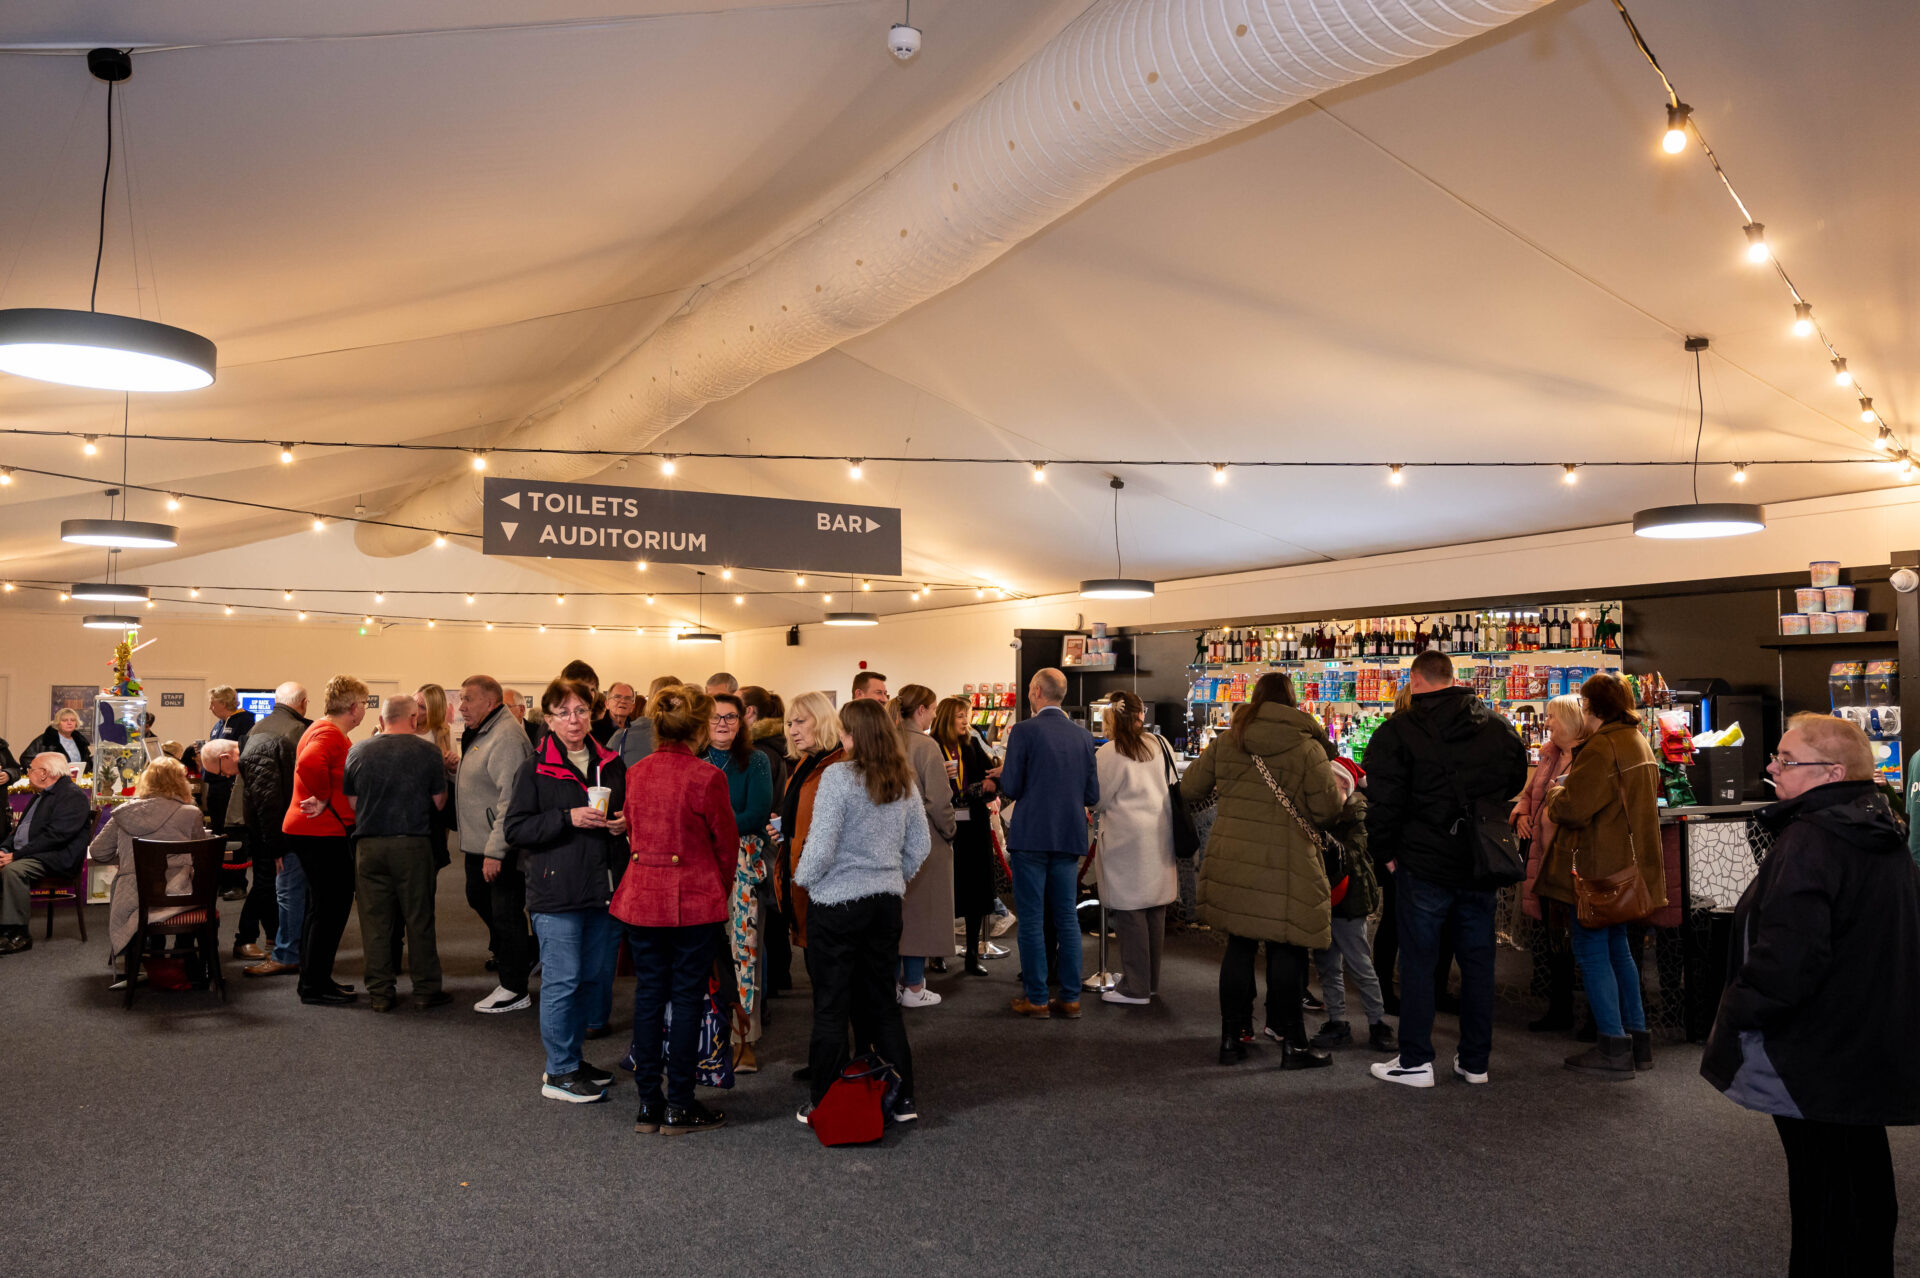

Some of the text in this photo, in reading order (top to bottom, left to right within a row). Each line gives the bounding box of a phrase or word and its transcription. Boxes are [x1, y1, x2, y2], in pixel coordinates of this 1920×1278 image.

[527, 491, 639, 518] TOILETS
[817, 512, 862, 533] BAR
[538, 524, 706, 552] AUDITORIUM
